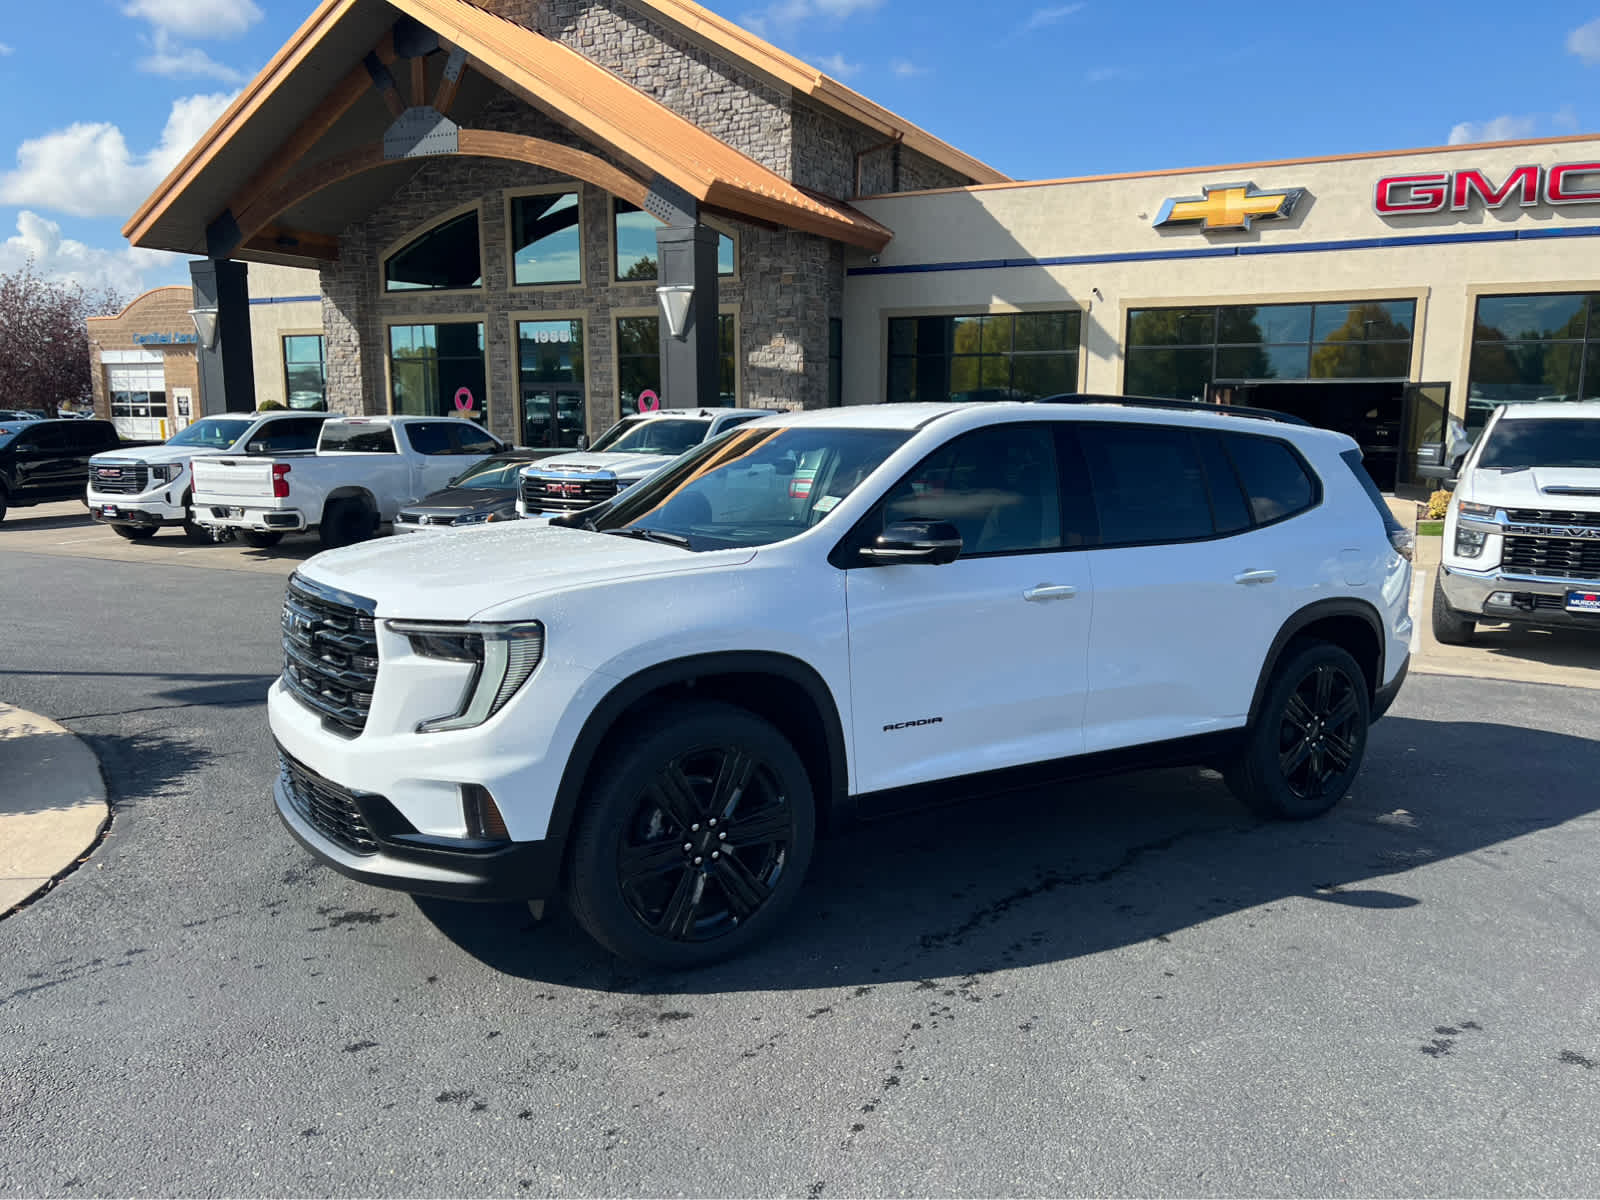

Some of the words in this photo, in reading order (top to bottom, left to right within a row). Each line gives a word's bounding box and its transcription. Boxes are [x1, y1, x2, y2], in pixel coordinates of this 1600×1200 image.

[1373, 160, 1600, 216] GMC
[133, 332, 172, 344] Certified
[546, 483, 581, 493] GMC
[883, 717, 943, 731] ACADIA
